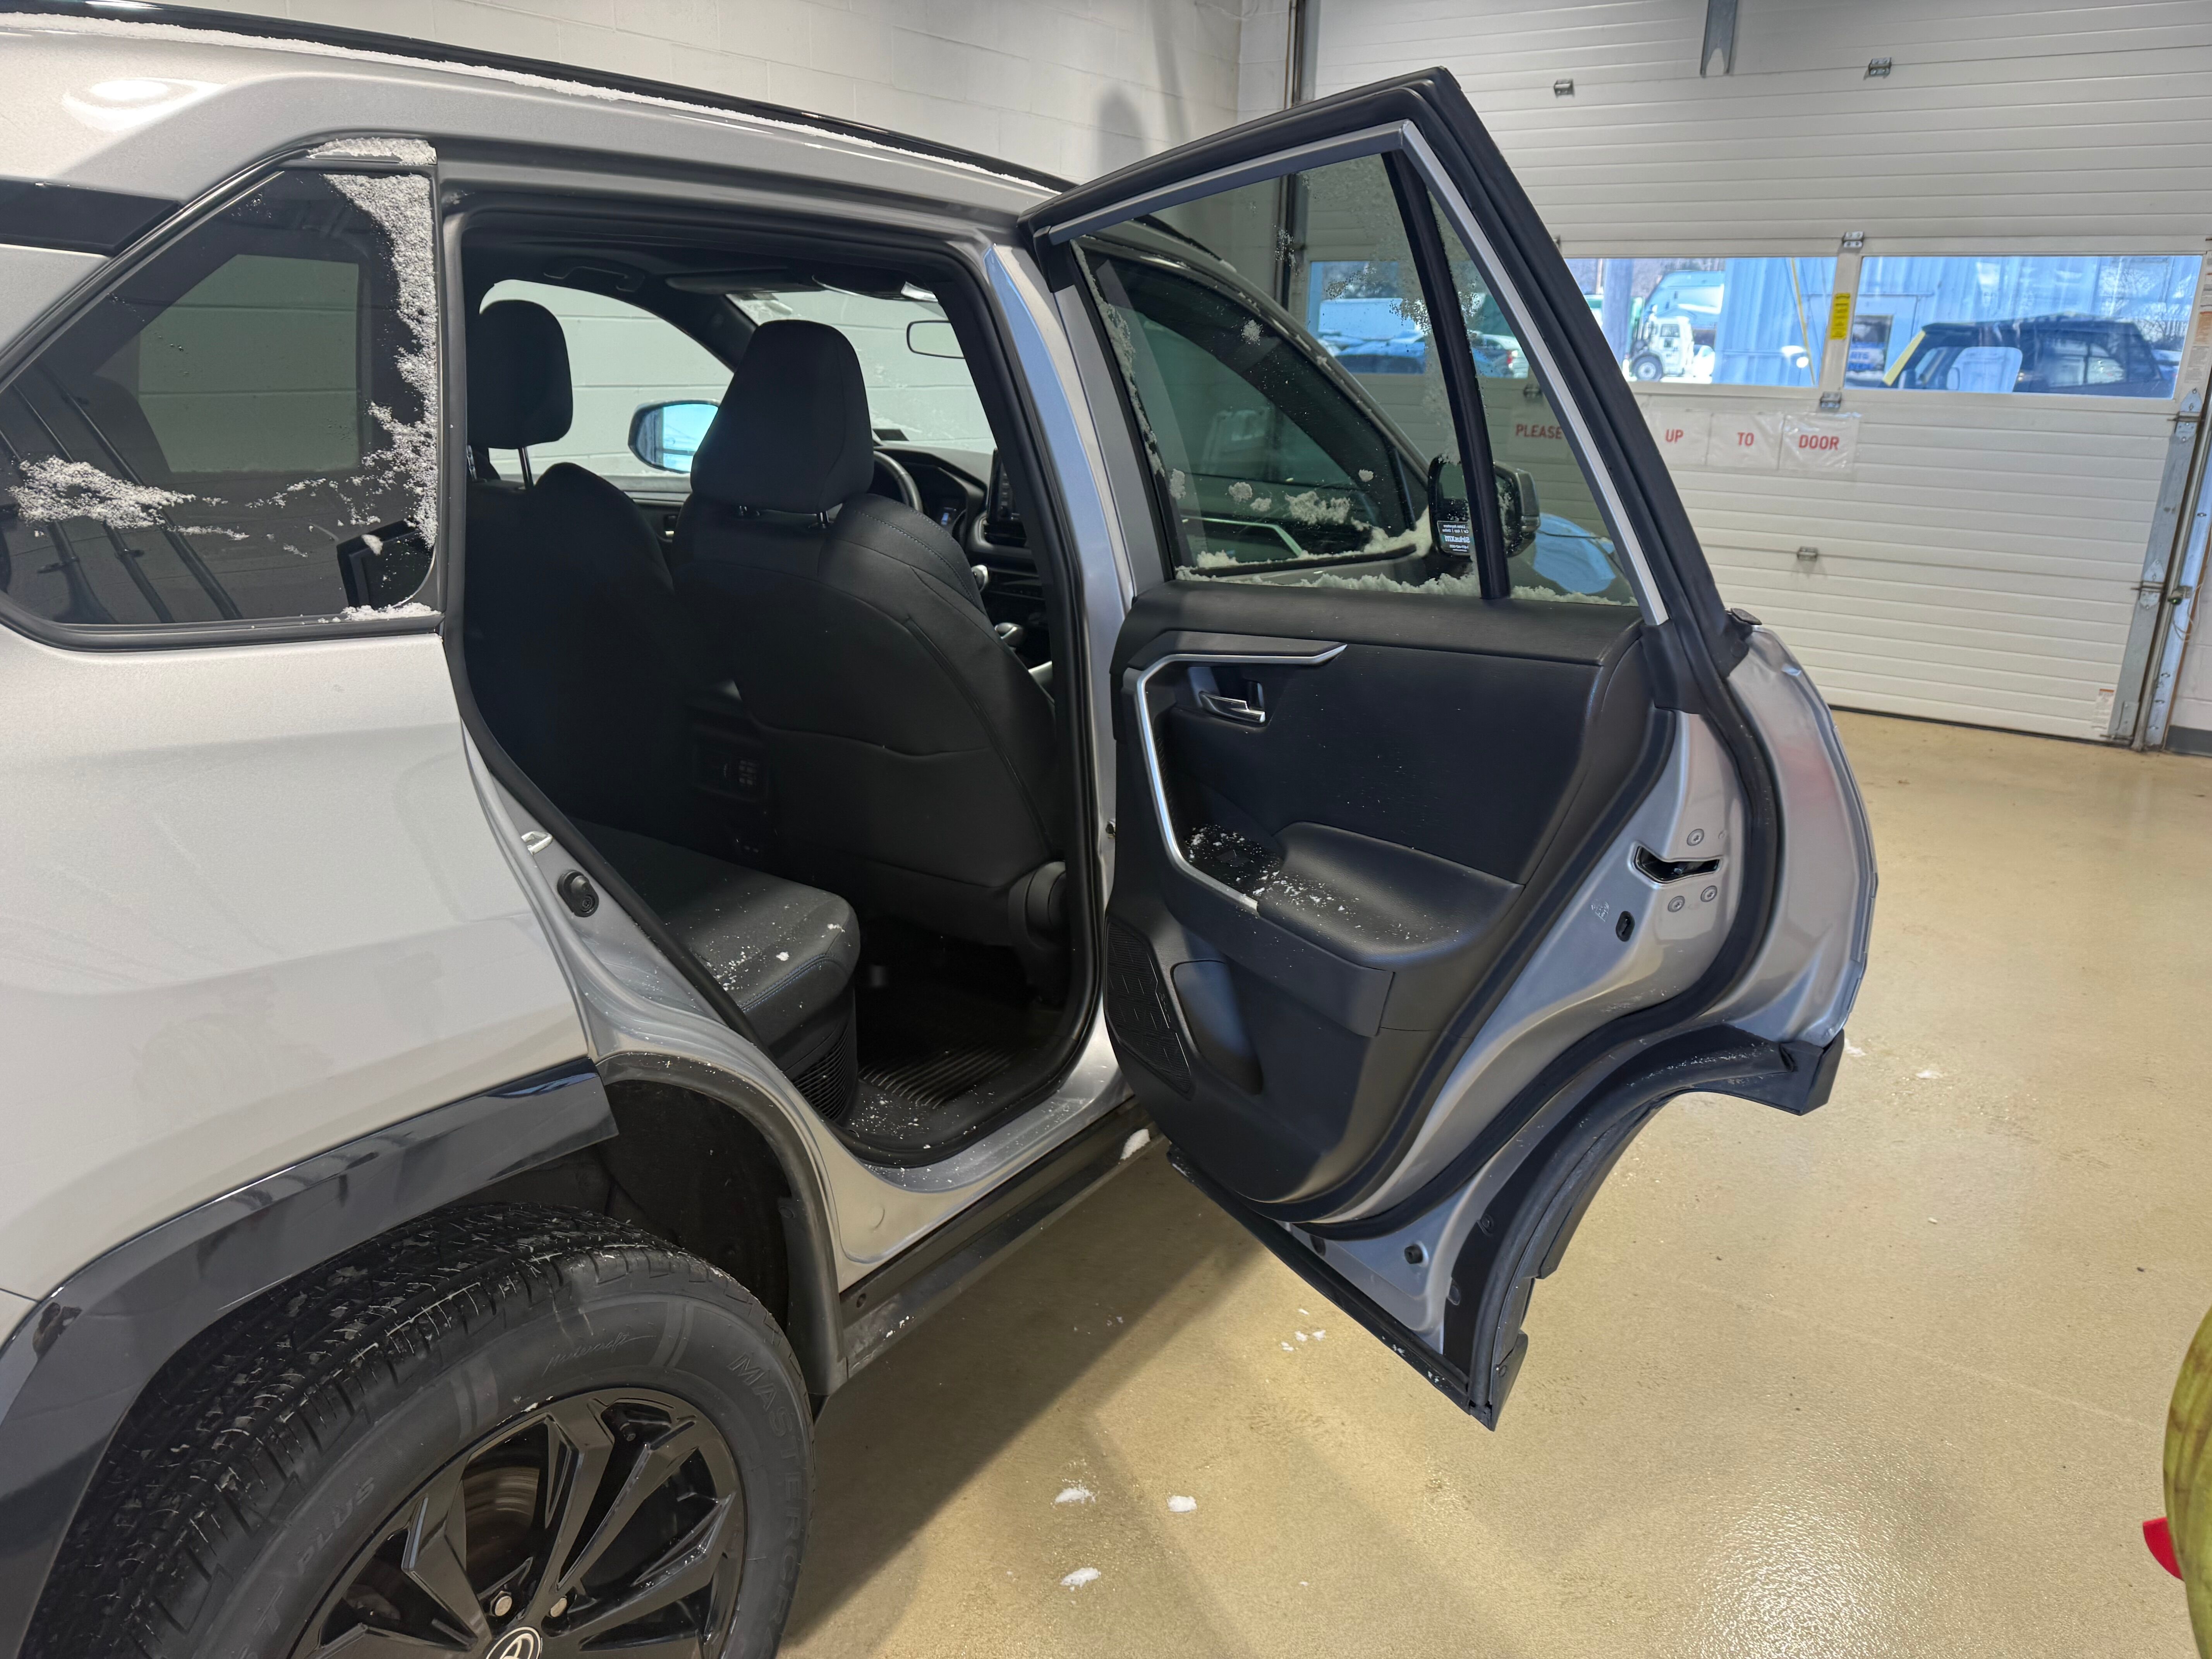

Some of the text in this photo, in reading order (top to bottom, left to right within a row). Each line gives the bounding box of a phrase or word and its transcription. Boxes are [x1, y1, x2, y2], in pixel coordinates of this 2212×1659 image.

[1516, 423, 1839, 450] PLEASE UP TO DOOR
[297, 1477, 375, 1575] PLUS
